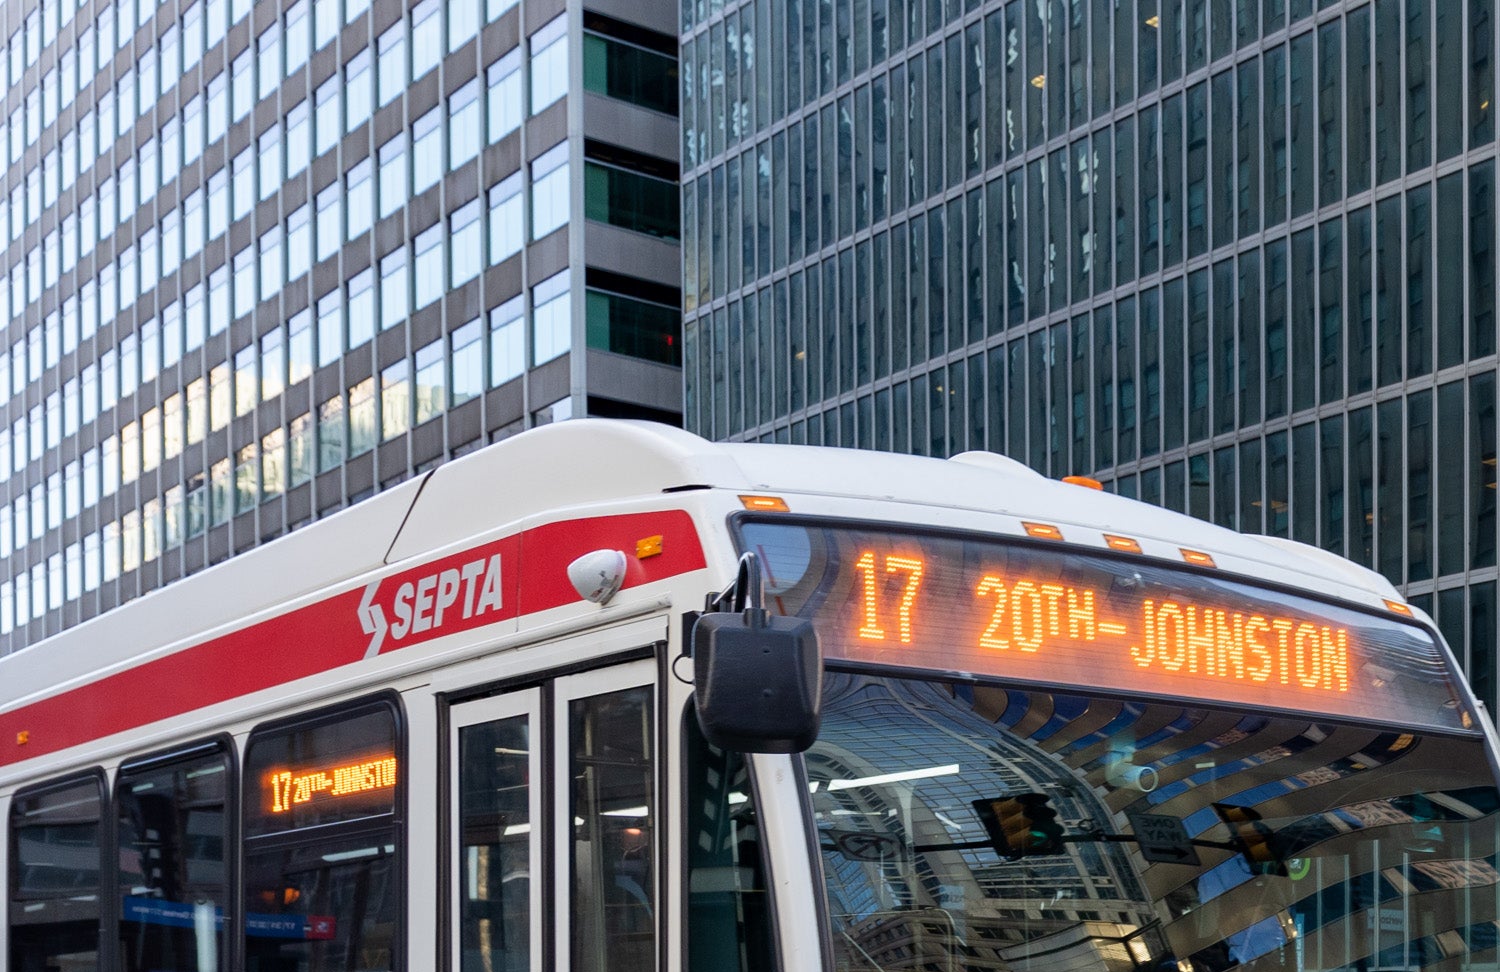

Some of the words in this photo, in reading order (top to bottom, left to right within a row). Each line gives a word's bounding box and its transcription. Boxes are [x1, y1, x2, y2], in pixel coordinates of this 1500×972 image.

[391, 553, 503, 640] SEPTA
[856, 553, 923, 643] 17
[271, 771, 292, 812] 17
